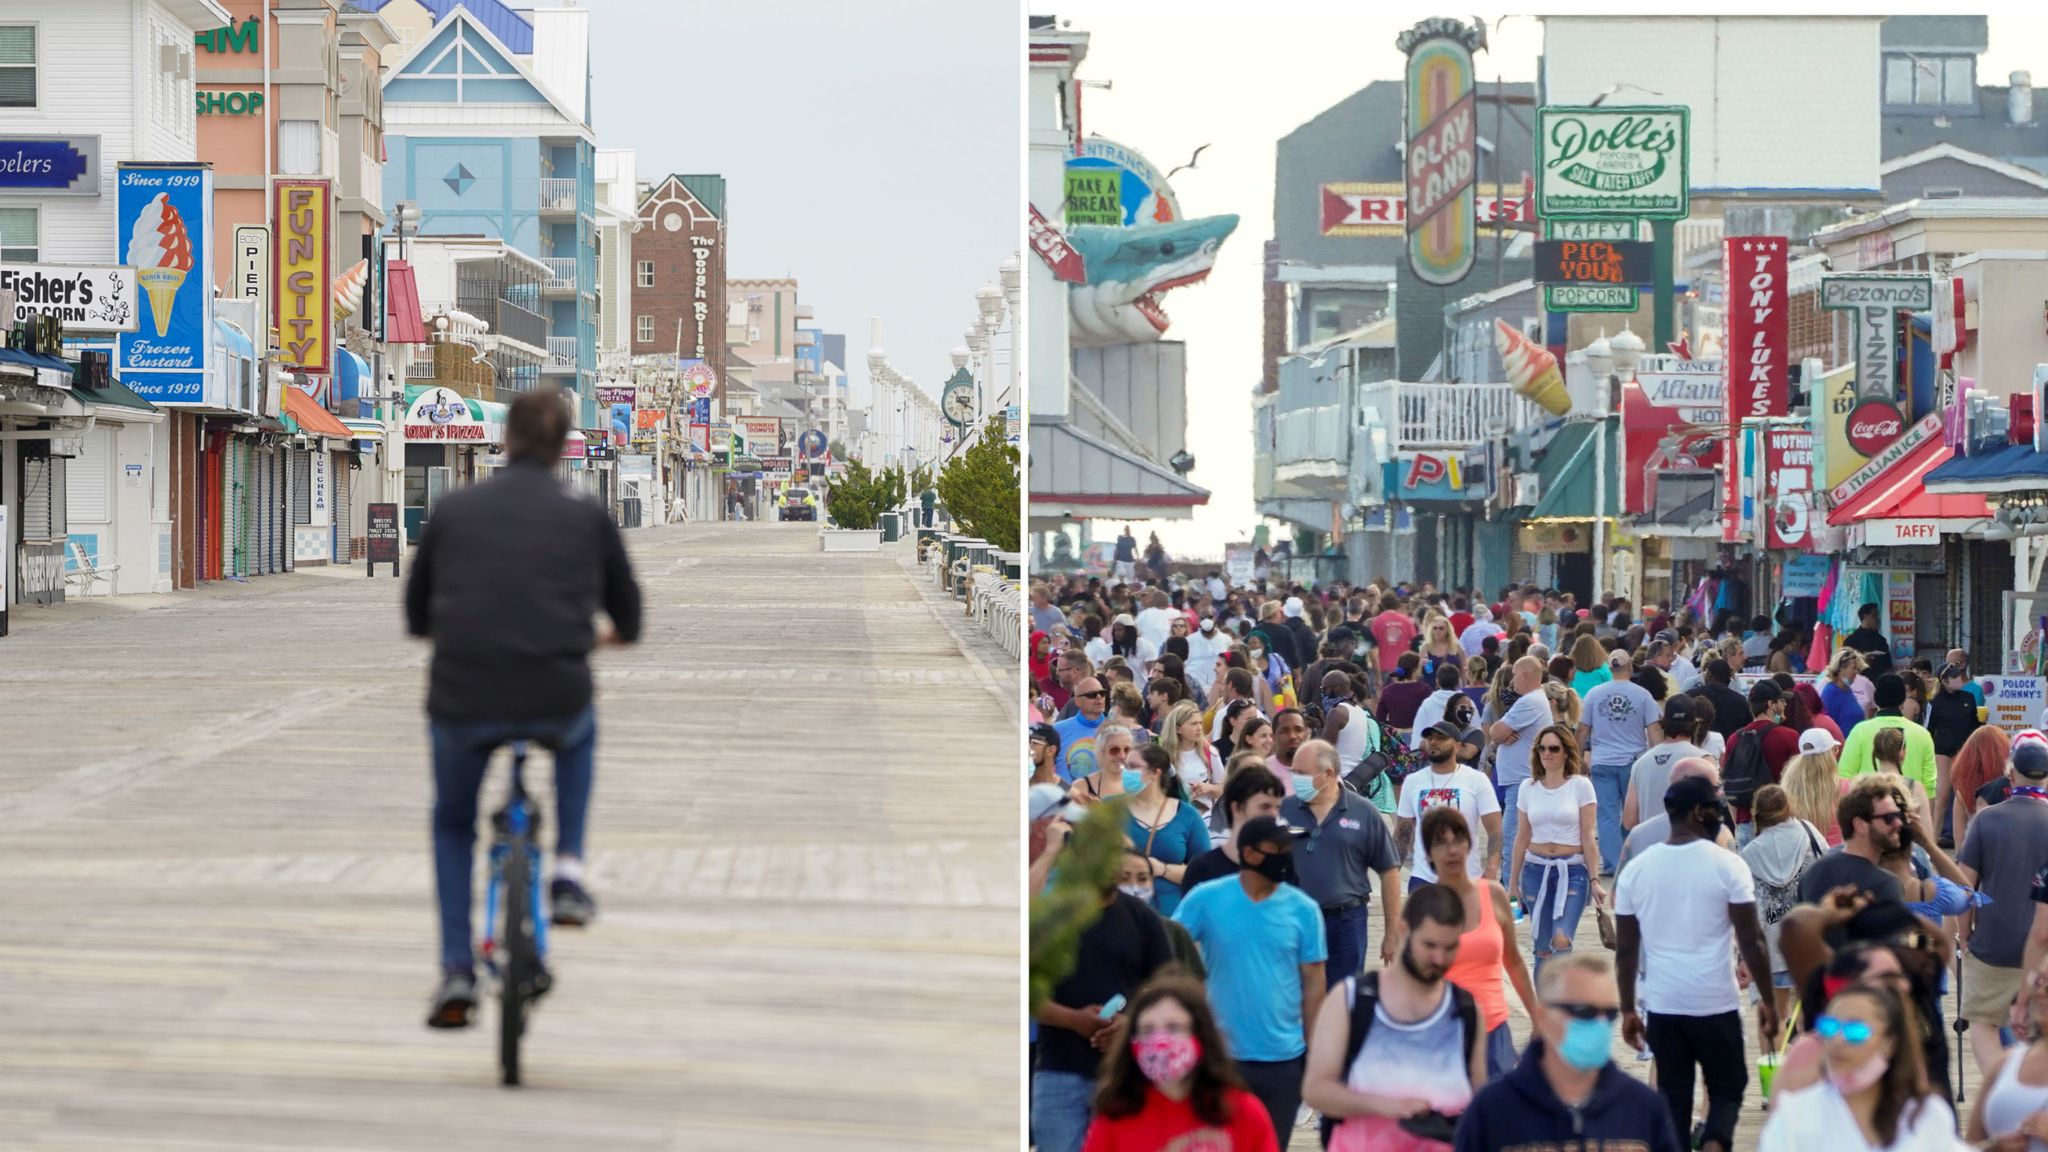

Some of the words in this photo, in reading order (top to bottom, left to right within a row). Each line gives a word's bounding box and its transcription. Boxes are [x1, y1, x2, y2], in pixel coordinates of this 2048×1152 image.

[196, 91, 264, 115] SHOP
[1411, 108, 1470, 178] PLAY
[1547, 116, 1675, 168] Dolle's
[122, 173, 163, 186] Since
[167, 175, 200, 187] 1919
[1069, 178, 1102, 194] TAKE
[1108, 179, 1116, 194] A
[1411, 149, 1472, 215] LAND
[1568, 164, 1596, 186] SALT
[1596, 172, 1630, 191] WATER
[1630, 168, 1656, 188] TAFFY
[1070, 196, 1117, 212] BREAK
[289, 190, 314, 265] FUN
[1070, 215, 1097, 225] FROM
[1101, 215, 1117, 225] THE
[1560, 224, 1625, 239] TAFFY
[690, 236, 715, 246] The
[246, 247, 258, 297] PIER
[692, 248, 710, 298] Dough
[1, 271, 94, 306] Fisher's
[1556, 289, 1627, 304] POPCORN
[1750, 255, 1773, 324] TONY
[1827, 283, 1926, 302] Piezano's
[288, 270, 317, 364] CITY
[130, 340, 191, 354] Frozen
[1863, 306, 1890, 397] PIZZA
[128, 354, 194, 367] Custard
[1676, 361, 1715, 372] SINCE
[1750, 331, 1772, 416] LUKES
[126, 381, 164, 394] Since
[167, 383, 200, 395] 1919
[446, 424, 486, 439] PIZZA
[1852, 420, 1900, 439] Coca-Cola
[1783, 450, 1814, 465] OVER
[1849, 446, 1902, 491] ITALIAN
[1901, 429, 1924, 451] ICE
[1895, 524, 1936, 539] TAFFY
[2003, 679, 2036, 688] POLOCK
[1999, 690, 2042, 699] JOHNNY'S
